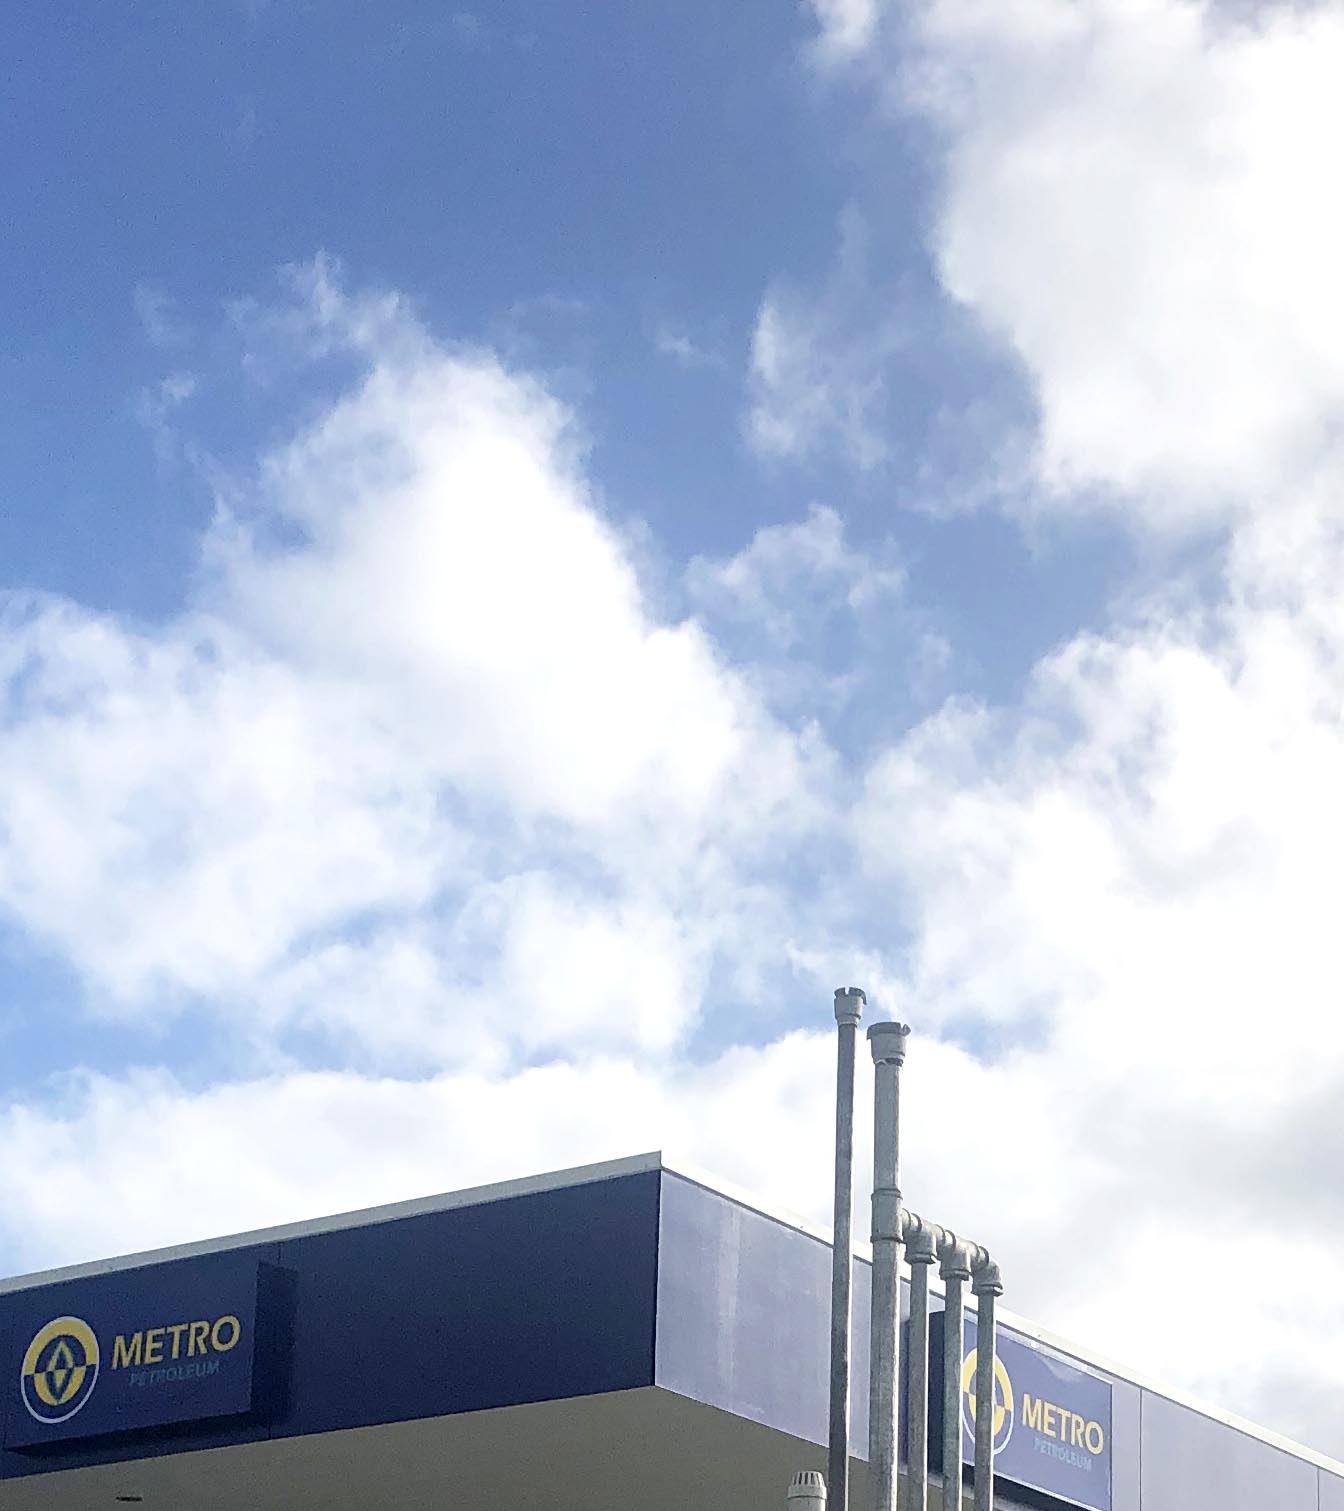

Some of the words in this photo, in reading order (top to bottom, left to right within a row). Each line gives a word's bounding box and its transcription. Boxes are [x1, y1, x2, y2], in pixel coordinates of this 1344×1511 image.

[111, 1315, 241, 1371] METRO
[128, 1360, 221, 1387] PETROLEUM
[1022, 1393, 1105, 1456] METRO
[1034, 1438, 1093, 1472] PETROLEUM
